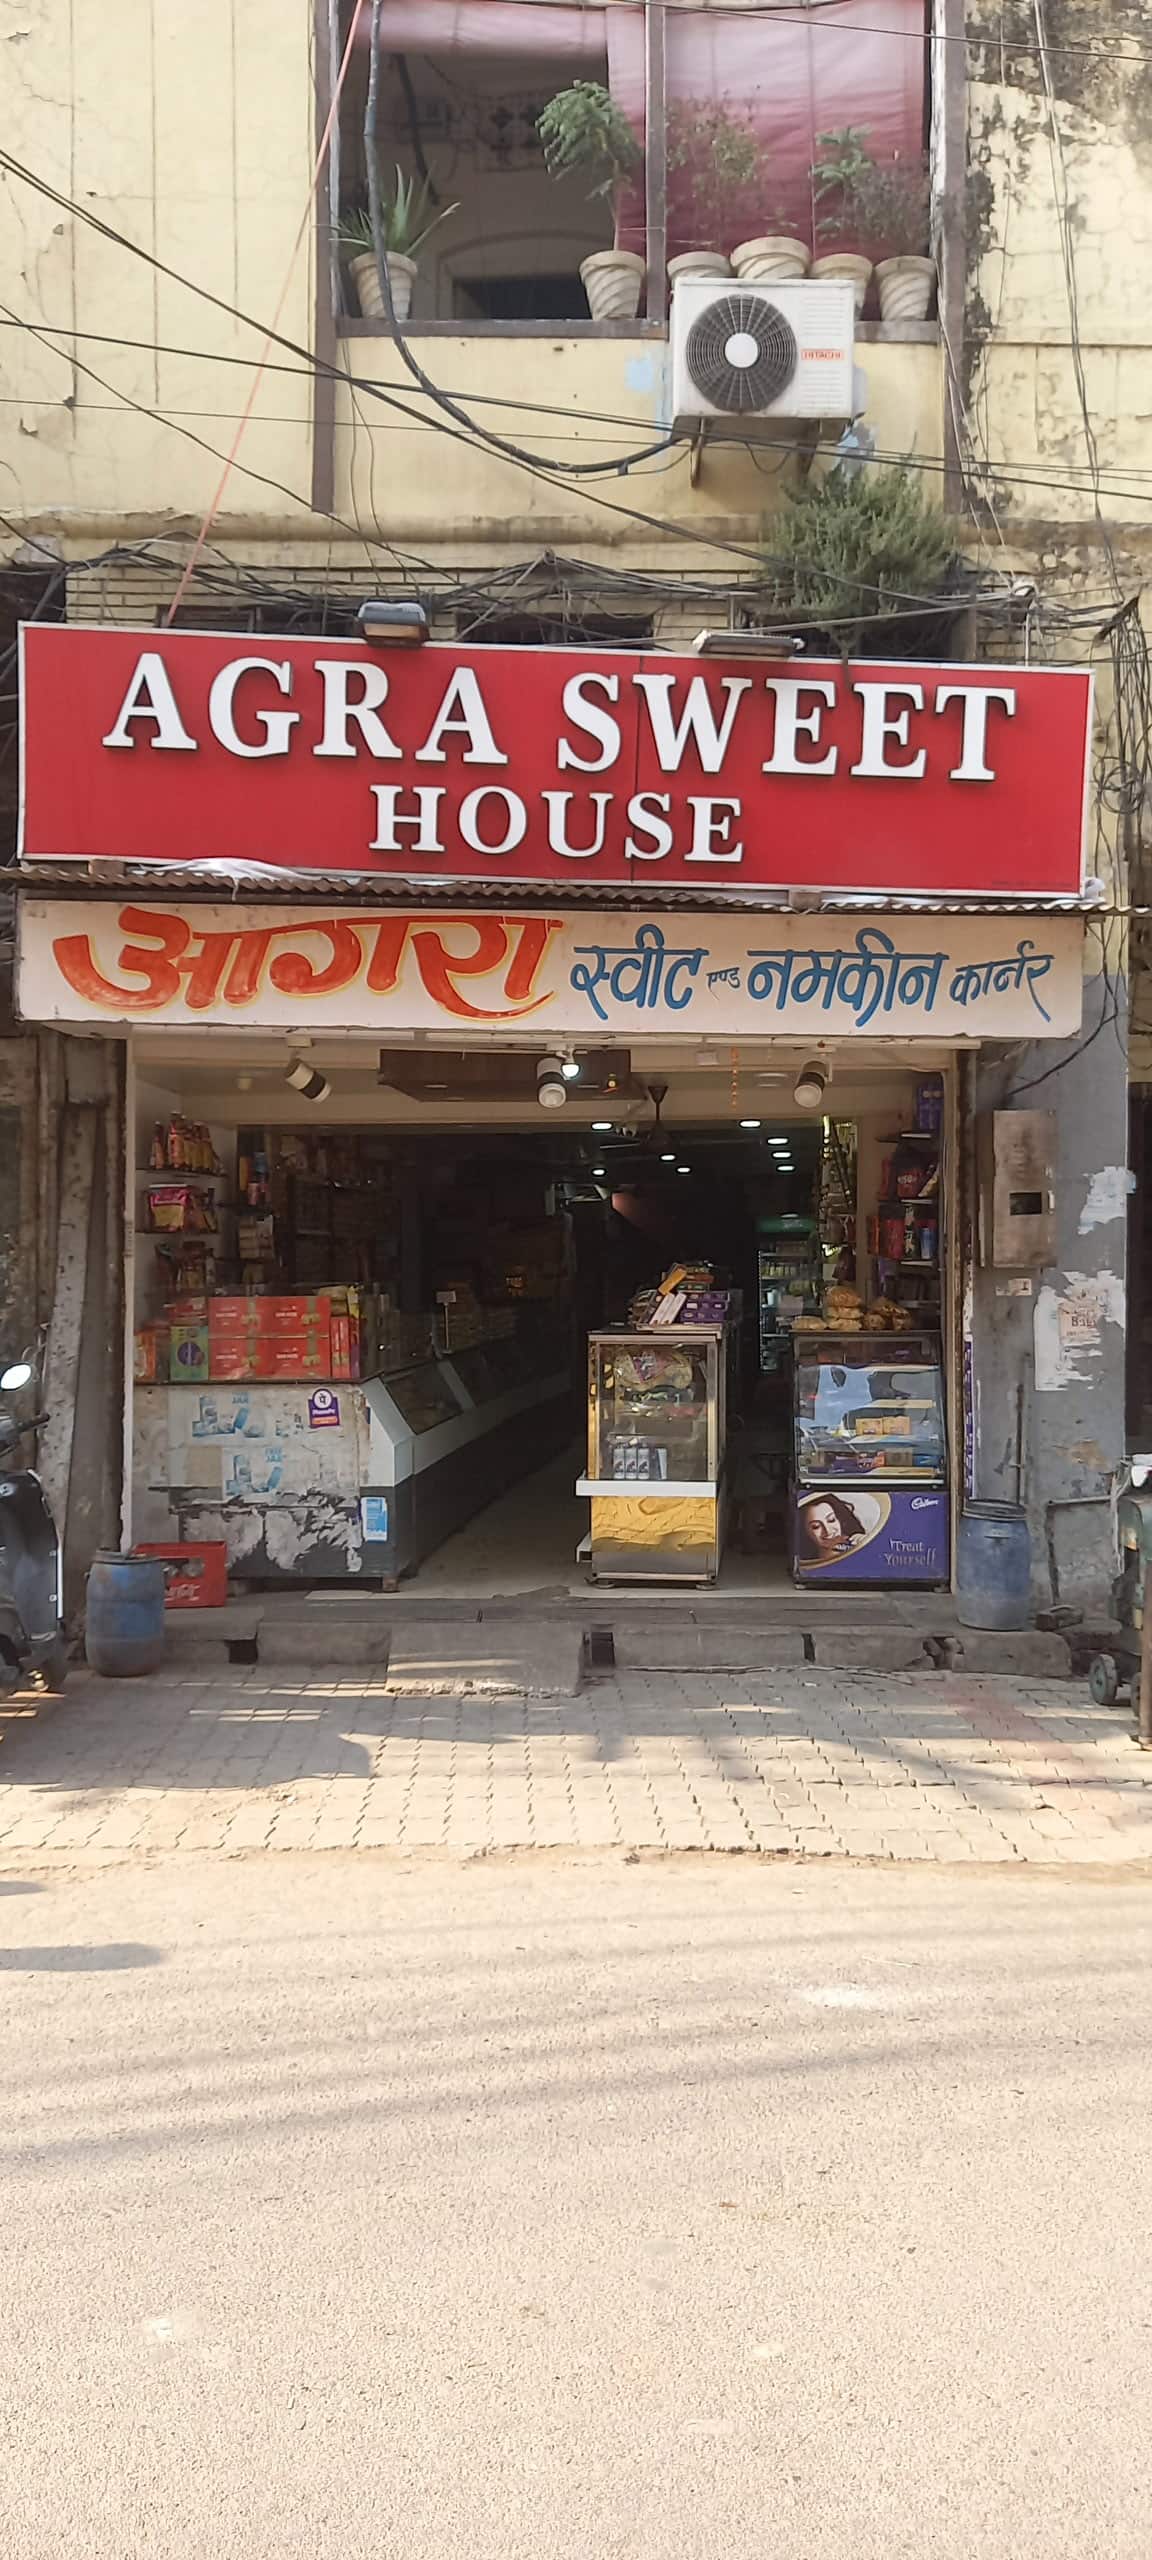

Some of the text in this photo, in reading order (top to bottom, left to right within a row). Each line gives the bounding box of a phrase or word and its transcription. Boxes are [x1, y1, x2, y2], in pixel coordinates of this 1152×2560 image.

[101, 651, 1017, 782] AGRA SWEET
[368, 784, 744, 863] HOUSE
[52, 905, 565, 1022] आगरा
[570, 923, 710, 1020] स्वीट
[747, 927, 950, 1028] नमकीन
[884, 1548, 937, 1569] Yourself
[889, 1538, 925, 1552] Treat
